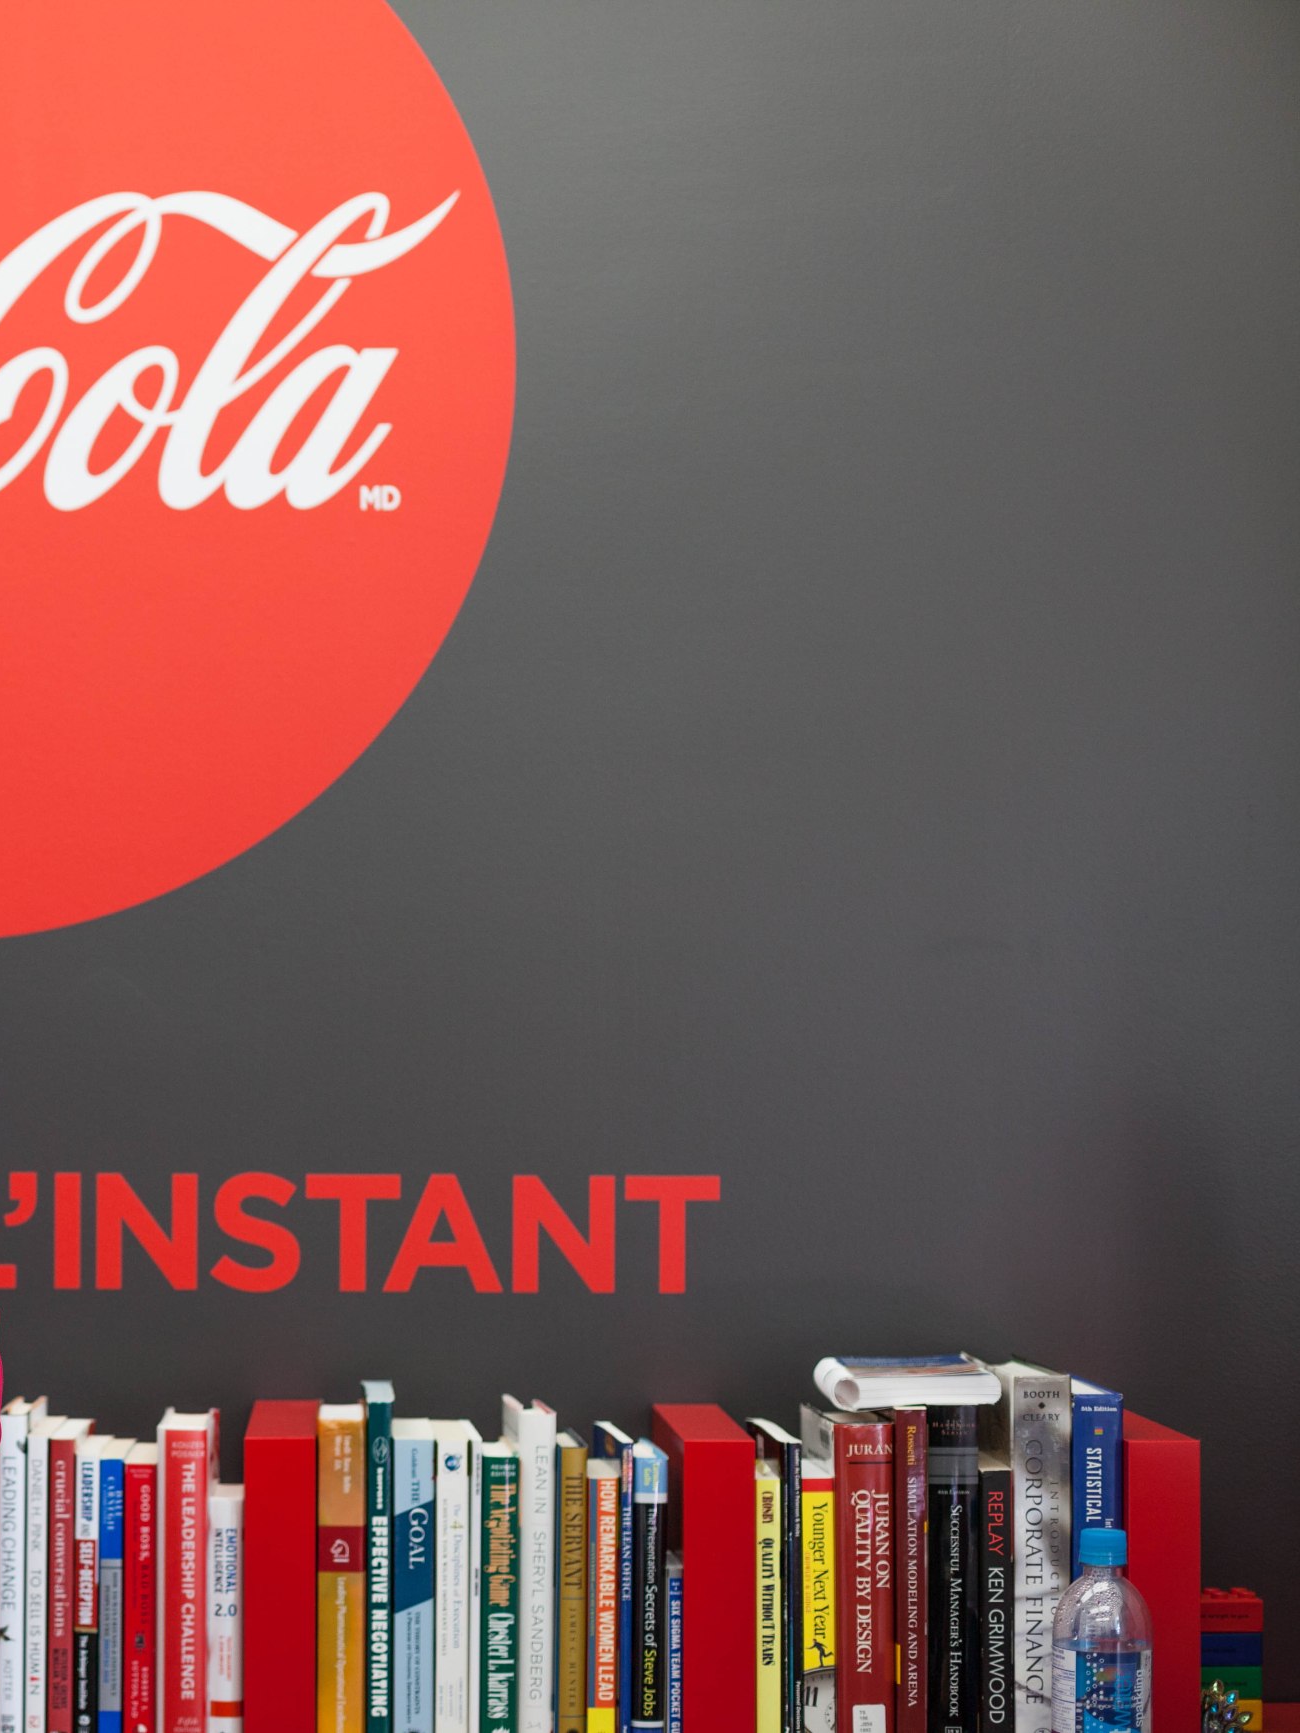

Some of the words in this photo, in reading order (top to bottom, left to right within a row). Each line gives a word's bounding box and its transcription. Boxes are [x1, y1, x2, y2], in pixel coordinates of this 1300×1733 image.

[359, 484, 402, 510] MD
[1023, 1390, 1060, 1399] BOOTH
[1022, 1413, 1060, 1423] CLEARY
[534, 1445, 548, 1491] LEAN
[846, 1443, 893, 1457] JURAN
[906, 1425, 917, 1466] Rossetti
[1, 1456, 17, 1537] LEADING
[53, 1459, 70, 1519] crucial
[82, 1461, 93, 1521] LEADERSHIP
[181, 1461, 196, 1493] THE
[411, 1480, 420, 1504] THE
[489, 1483, 516, 1505] The
[564, 1473, 583, 1508] THE
[598, 1480, 615, 1513] HOW
[1086, 1447, 1102, 1523] STATISTICAL
[139, 1485, 151, 1522] GOOD
[533, 1497, 547, 1514] IN
[622, 1505, 631, 1528] THE
[761, 1491, 774, 1525] CROSBY
[872, 1490, 890, 1555] JURAN
[906, 1477, 917, 1556] SIMULATION
[988, 1491, 1004, 1556] REPLAY
[1025, 1440, 1043, 1584] CORPORATE
[181, 1497, 196, 1599] LEADERSHIP
[408, 1507, 428, 1570] GOAL
[483, 1507, 516, 1574] Negotiating
[564, 1512, 583, 1590] SERVANT
[622, 1531, 631, 1559] LEAN
[808, 1503, 829, 1566] Younger
[851, 1490, 871, 1571] QUALITY
[949, 1504, 962, 1574] SUCCESSFUL
[1049, 1481, 1059, 1624] INTRODUCTIO
[1, 1540, 17, 1611] CHANGE
[30, 1569, 43, 1588] TO
[215, 1528, 224, 1594] INTELLIGENCE
[226, 1528, 237, 1594] EMOTIONAL
[371, 1516, 388, 1603] EFFECTIVE
[532, 1531, 546, 1597] SHERYL
[598, 1515, 615, 1608] REMARKABLE
[646, 1527, 656, 1584] Presentation
[758, 1538, 775, 1581] QUALITY
[875, 1560, 890, 1589] ON
[53, 1523, 70, 1637] conversations
[79, 1541, 94, 1625] SELF-DECEPTION
[489, 1574, 516, 1607] Game
[622, 1562, 631, 1601] OFFICE
[813, 1569, 829, 1604] Next
[856, 1576, 871, 1601] BY
[906, 1559, 917, 1629] MODELING
[988, 1566, 1004, 1603] KEN
[30, 1593, 43, 1620] SELL
[214, 1603, 237, 1617] 2.0
[644, 1584, 657, 1632] Secrets
[671, 1600, 680, 1616] SIX
[761, 1584, 775, 1631] WITHOUT
[814, 1606, 829, 1639] Year
[949, 1577, 962, 1648] MANAGER'S
[30, 1625, 43, 1637] IS
[181, 1602, 196, 1700] CHALLENGE
[487, 1612, 515, 1658] Chester
[529, 1605, 544, 1701] SANDBERG
[598, 1611, 615, 1663] WOMEN
[644, 1633, 657, 1648] of
[671, 1618, 680, 1650] SIGMA
[761, 1634, 775, 1666] TEARS
[856, 1604, 871, 1673] DESIGN
[906, 1631, 917, 1660] AND
[1025, 1596, 1043, 1705] FINANCE
[371, 1609, 388, 1717] NEGOTIATING
[598, 1666, 615, 1701] LEAD
[643, 1649, 656, 1684] Steve
[671, 1652, 680, 1679] TEAM
[906, 1661, 917, 1707] ARENA
[949, 1651, 962, 1718] HANDBOOK
[988, 1609, 1004, 1724] GRIMWOOD
[487, 1672, 515, 1719] Karrass
[643, 1686, 656, 1717] Jobs
[671, 1682, 680, 1718] POCKET
